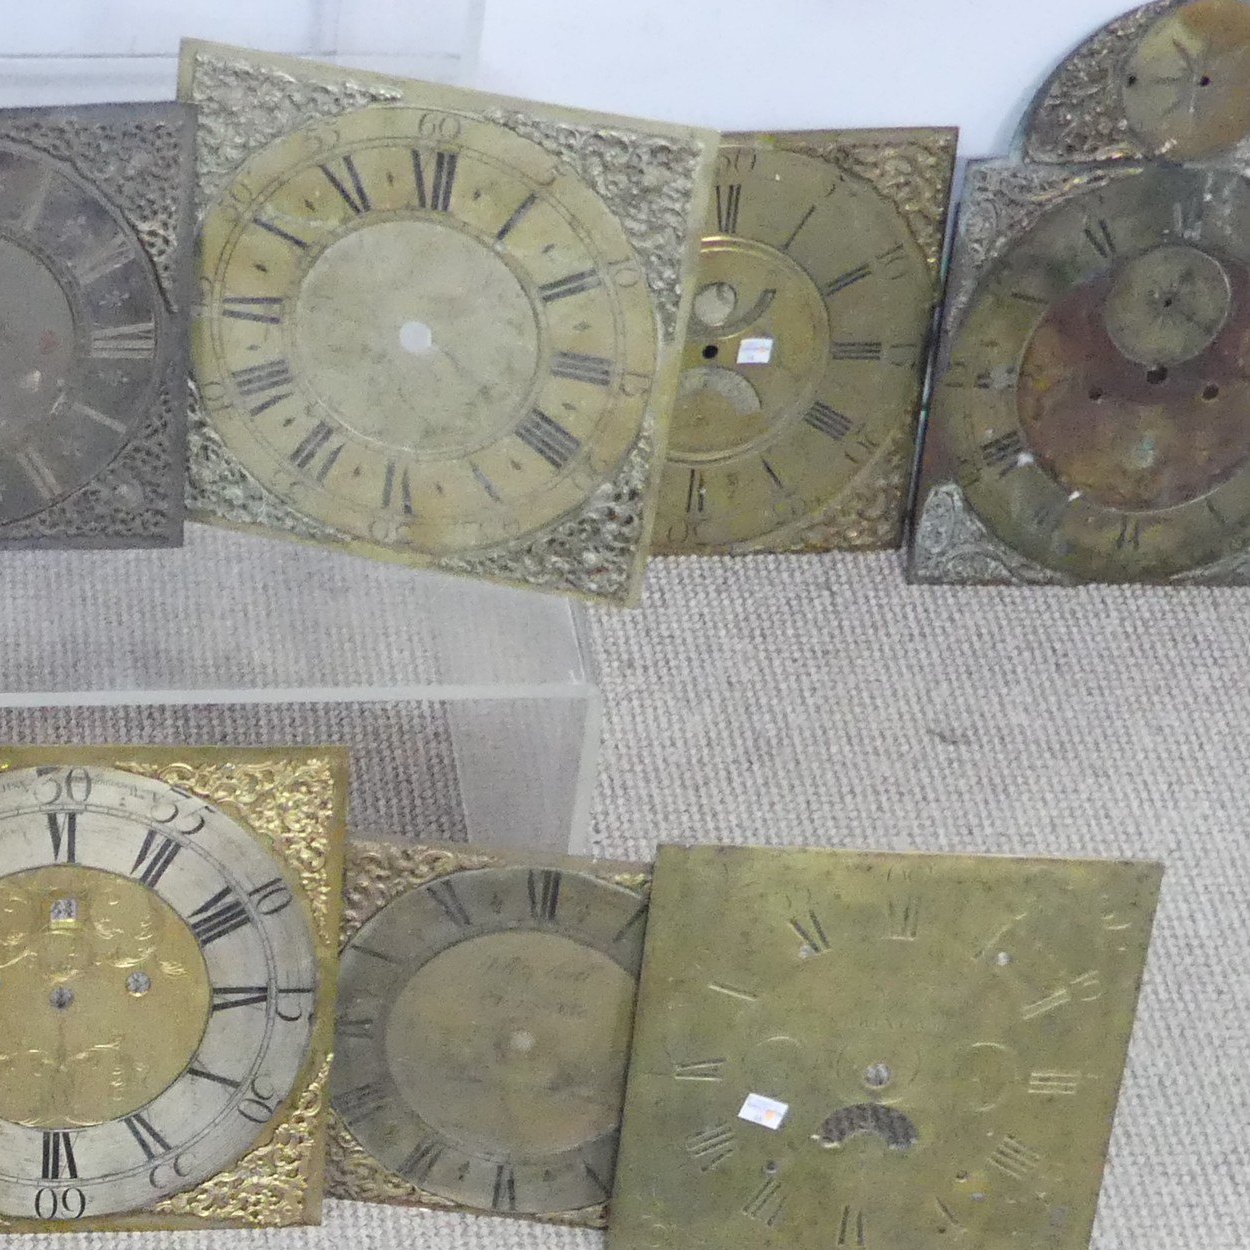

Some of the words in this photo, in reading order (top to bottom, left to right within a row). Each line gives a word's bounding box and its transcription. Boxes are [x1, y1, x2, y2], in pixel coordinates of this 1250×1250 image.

[318, 154, 373, 214] XI
[411, 148, 460, 213] XII
[495, 191, 538, 242] I
[46, 811, 78, 864] VI
[128, 827, 184, 888] VII
[186, 883, 253, 947] VIII
[210, 985, 270, 1012] IX
[41, 1129, 81, 1181] XII
[122, 1112, 176, 1160] XI
